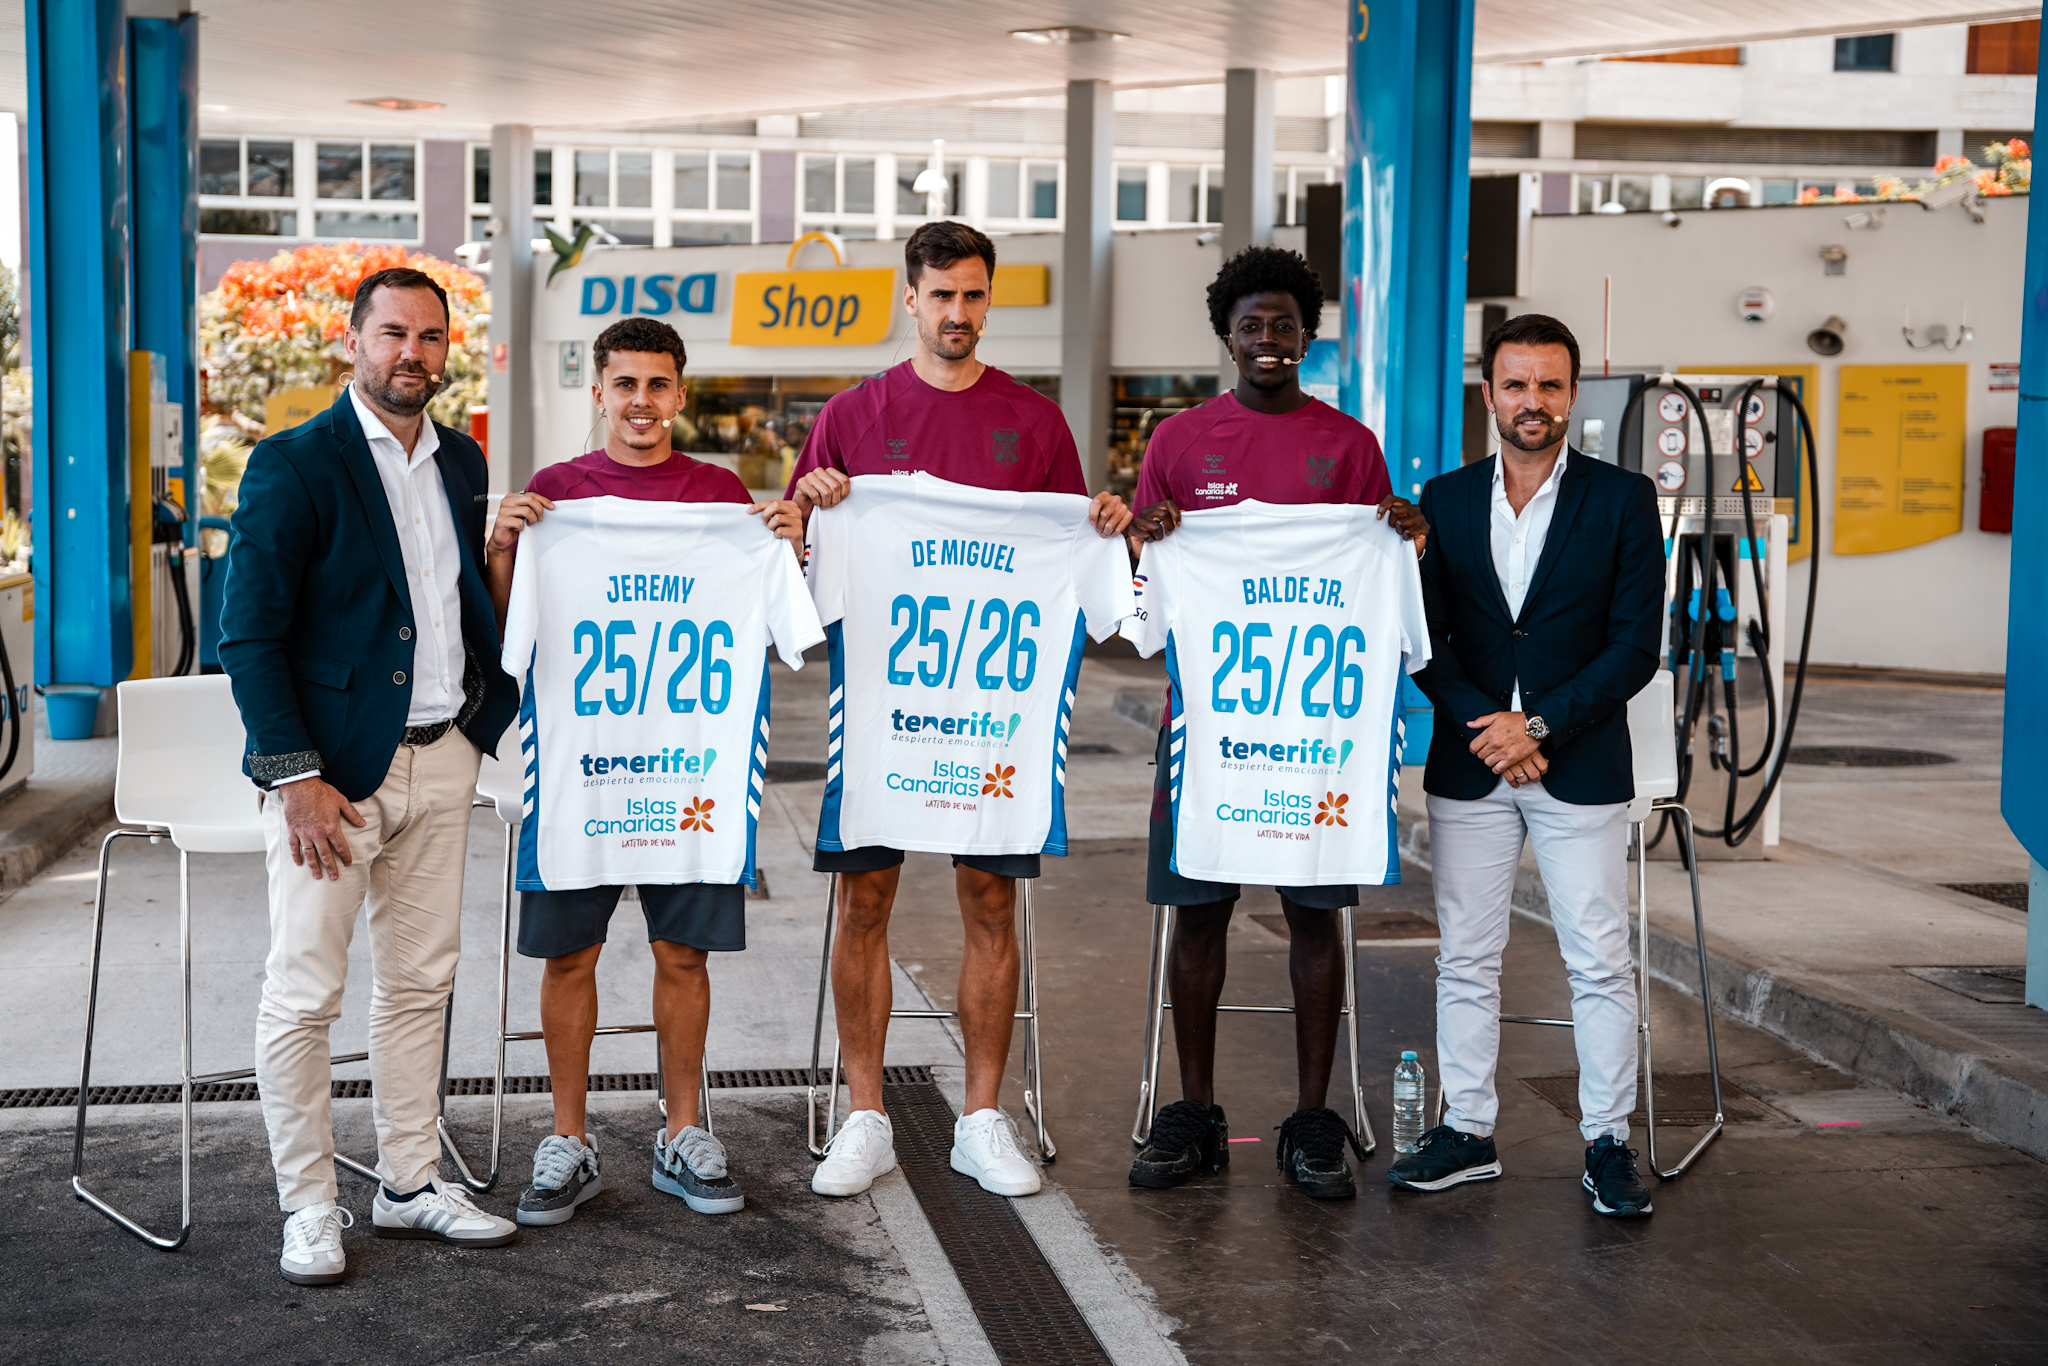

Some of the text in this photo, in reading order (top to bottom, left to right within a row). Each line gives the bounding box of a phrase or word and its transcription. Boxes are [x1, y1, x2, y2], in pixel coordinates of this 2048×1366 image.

[759, 283, 860, 337] Shop
[912, 539, 1015, 573] DE MIGUEL
[606, 574, 695, 604] JEREMY
[1243, 576, 1345, 608] BALDE JR.
[887, 593, 1041, 692] 25/26
[574, 619, 734, 716] 25/26
[1211, 620, 1366, 719] 25/26
[891, 733, 1003, 748] despierta emociones
[933, 760, 980, 780] Islas
[1220, 760, 1334, 775] despierta emociones
[583, 775, 698, 788] despierta emociones
[886, 773, 979, 797] Canarias
[627, 797, 676, 815] Islas
[953, 802, 961, 810] DE
[963, 803, 977, 811] VIDA
[1264, 789, 1312, 809] Islas
[584, 814, 676, 837] Canarias
[1216, 803, 1311, 826] Canarias
[650, 838, 659, 846] DE
[660, 838, 676, 847] VIDA
[1286, 832, 1294, 840] DE
[1295, 833, 1310, 841] VIDA
